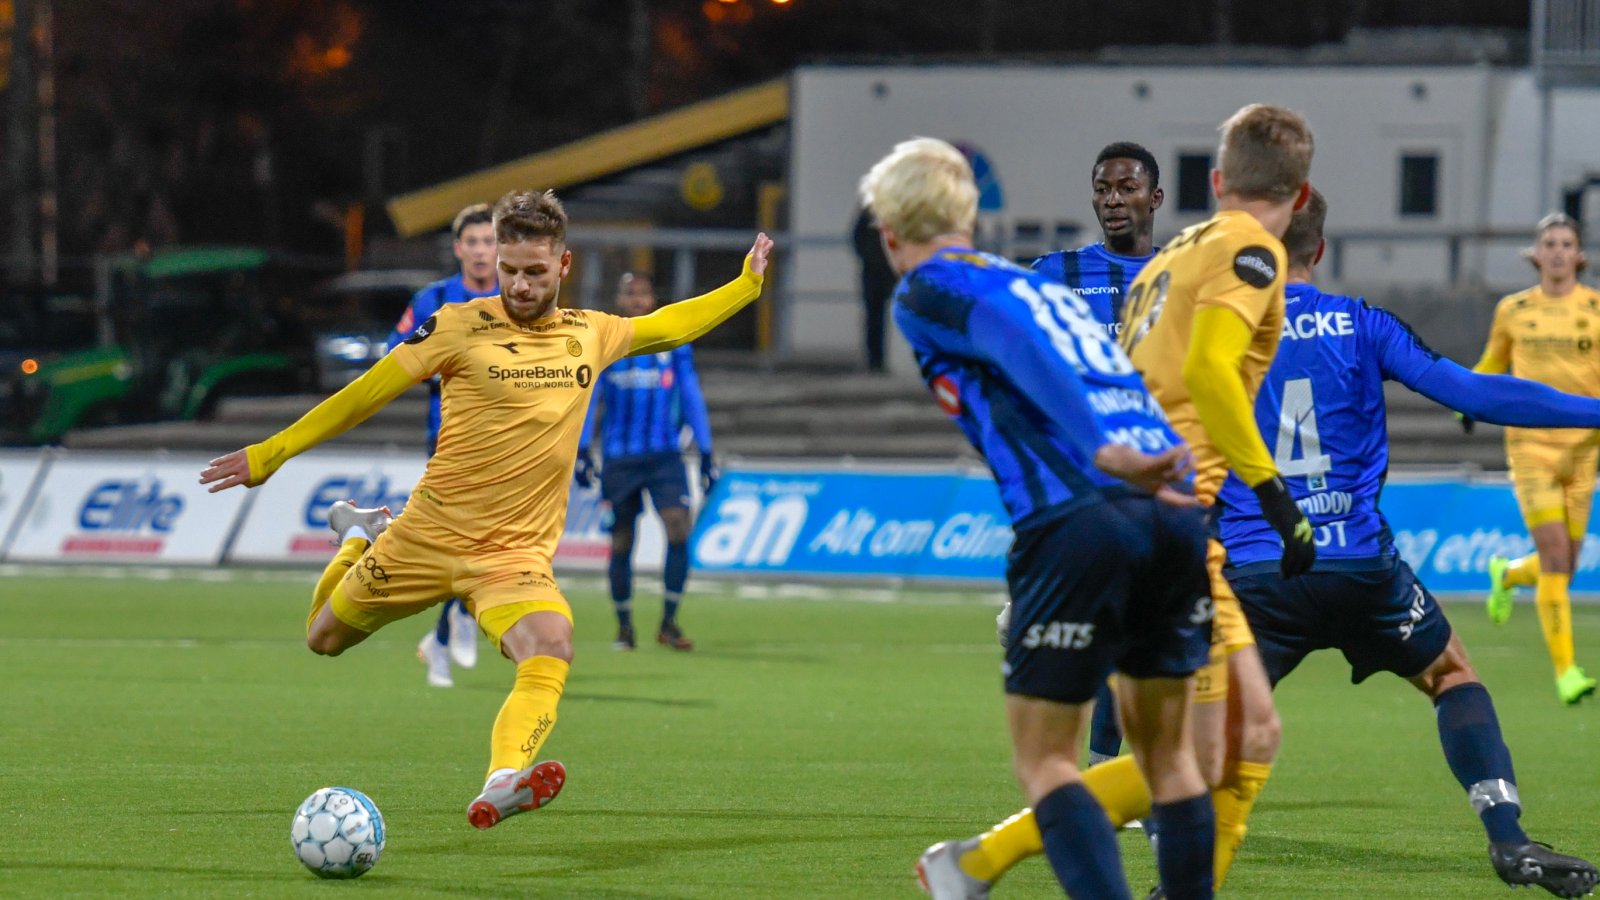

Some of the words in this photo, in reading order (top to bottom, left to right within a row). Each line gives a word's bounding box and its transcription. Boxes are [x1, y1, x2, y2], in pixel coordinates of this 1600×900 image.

[1072, 285, 1119, 296] macron
[1008, 277, 1136, 376] 18
[1279, 311, 1355, 341] ACKE
[488, 365, 573, 381] SpareBank
[514, 380, 574, 389] NORD-NORGE
[1275, 378, 1332, 490] 4
[78, 477, 184, 532] Elite
[1296, 491, 1353, 514] MIDOV
[696, 492, 809, 567] an
[808, 507, 877, 556] Alt
[869, 519, 935, 557] om
[932, 512, 1016, 560] Glim
[1313, 521, 1347, 548] OT
[1022, 621, 1096, 649] SATS
[521, 712, 553, 759] Scandic
